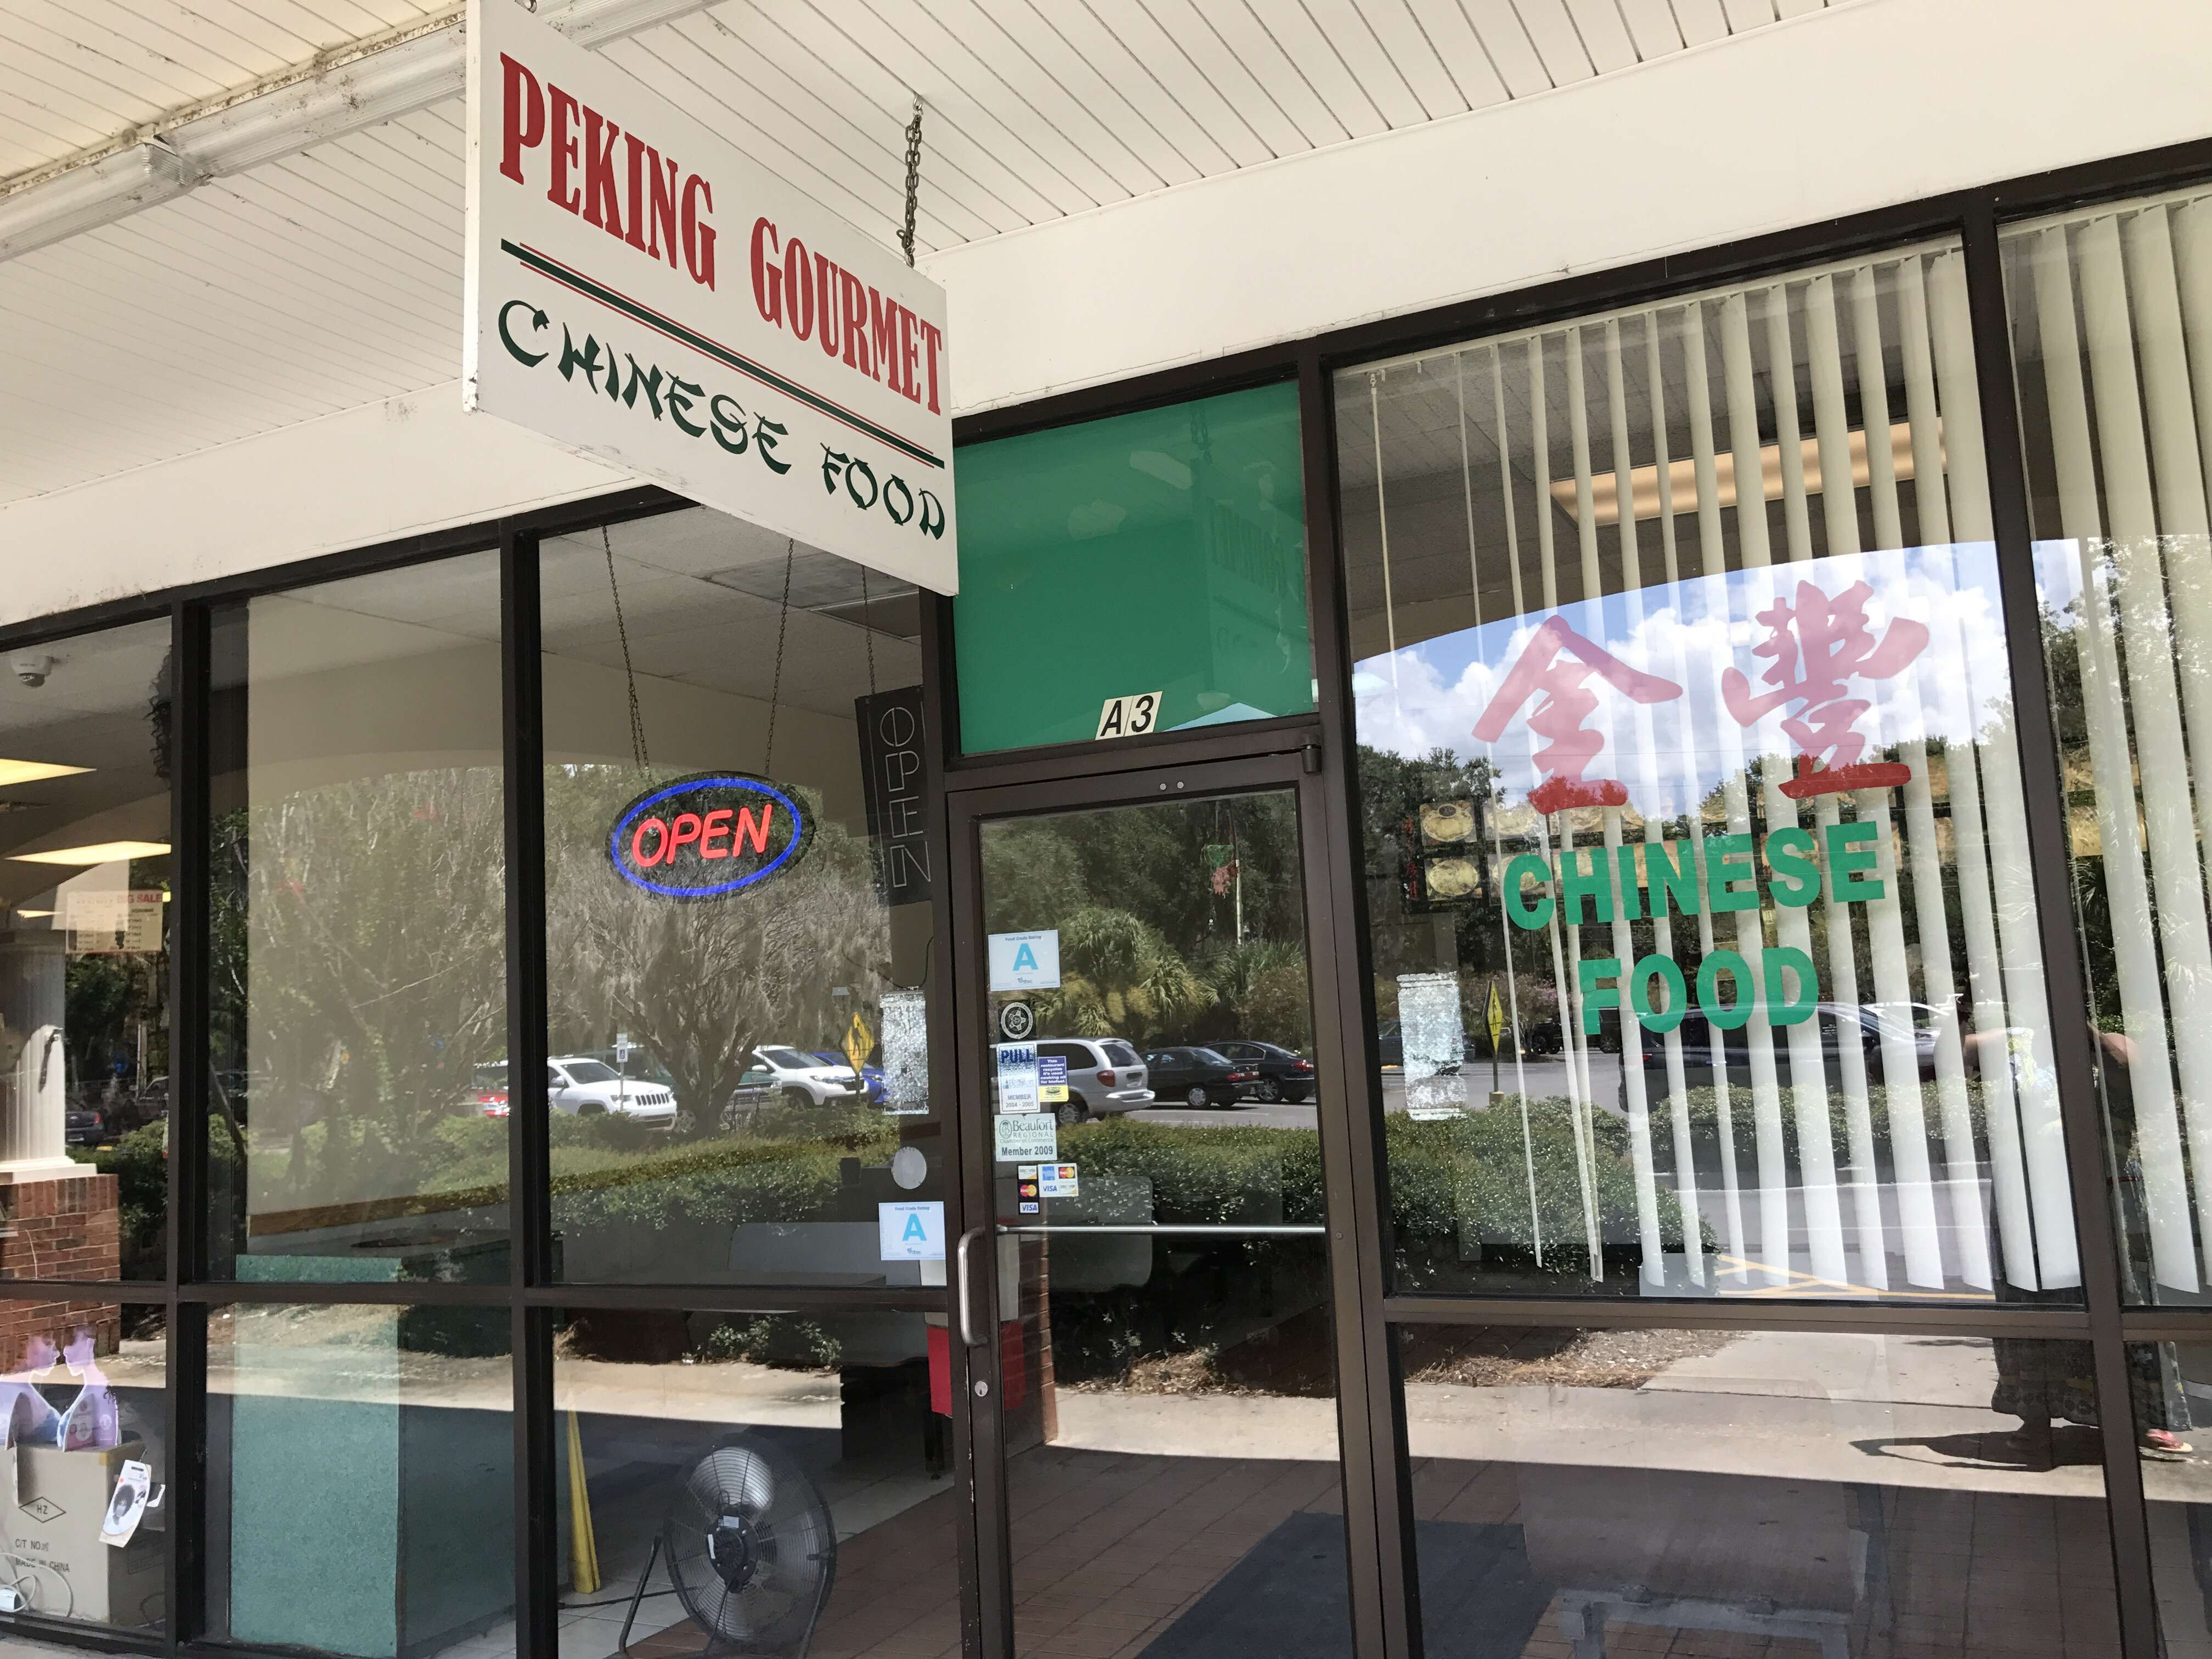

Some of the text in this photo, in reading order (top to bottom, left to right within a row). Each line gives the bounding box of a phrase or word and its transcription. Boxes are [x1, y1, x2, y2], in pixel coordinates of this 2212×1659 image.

[500, 52, 943, 416] PEKING GOURMET
[498, 300, 945, 540] CHINESE FOOD
[1099, 695, 1154, 737] A3
[879, 707, 932, 888] OPEN
[631, 804, 773, 867] OPEN
[1504, 821, 1885, 930] CHINESE
[137, 894, 162, 903] SALE
[1012, 943, 1039, 971] A
[1578, 947, 1819, 1035] FOOD
[1000, 1048, 1034, 1064] PULL
[1013, 1118, 1053, 1131] Beaufort
[1001, 1146, 1053, 1156] Member 2009
[901, 1212, 928, 1242] A
[37, 1504, 48, 1515] HZ
